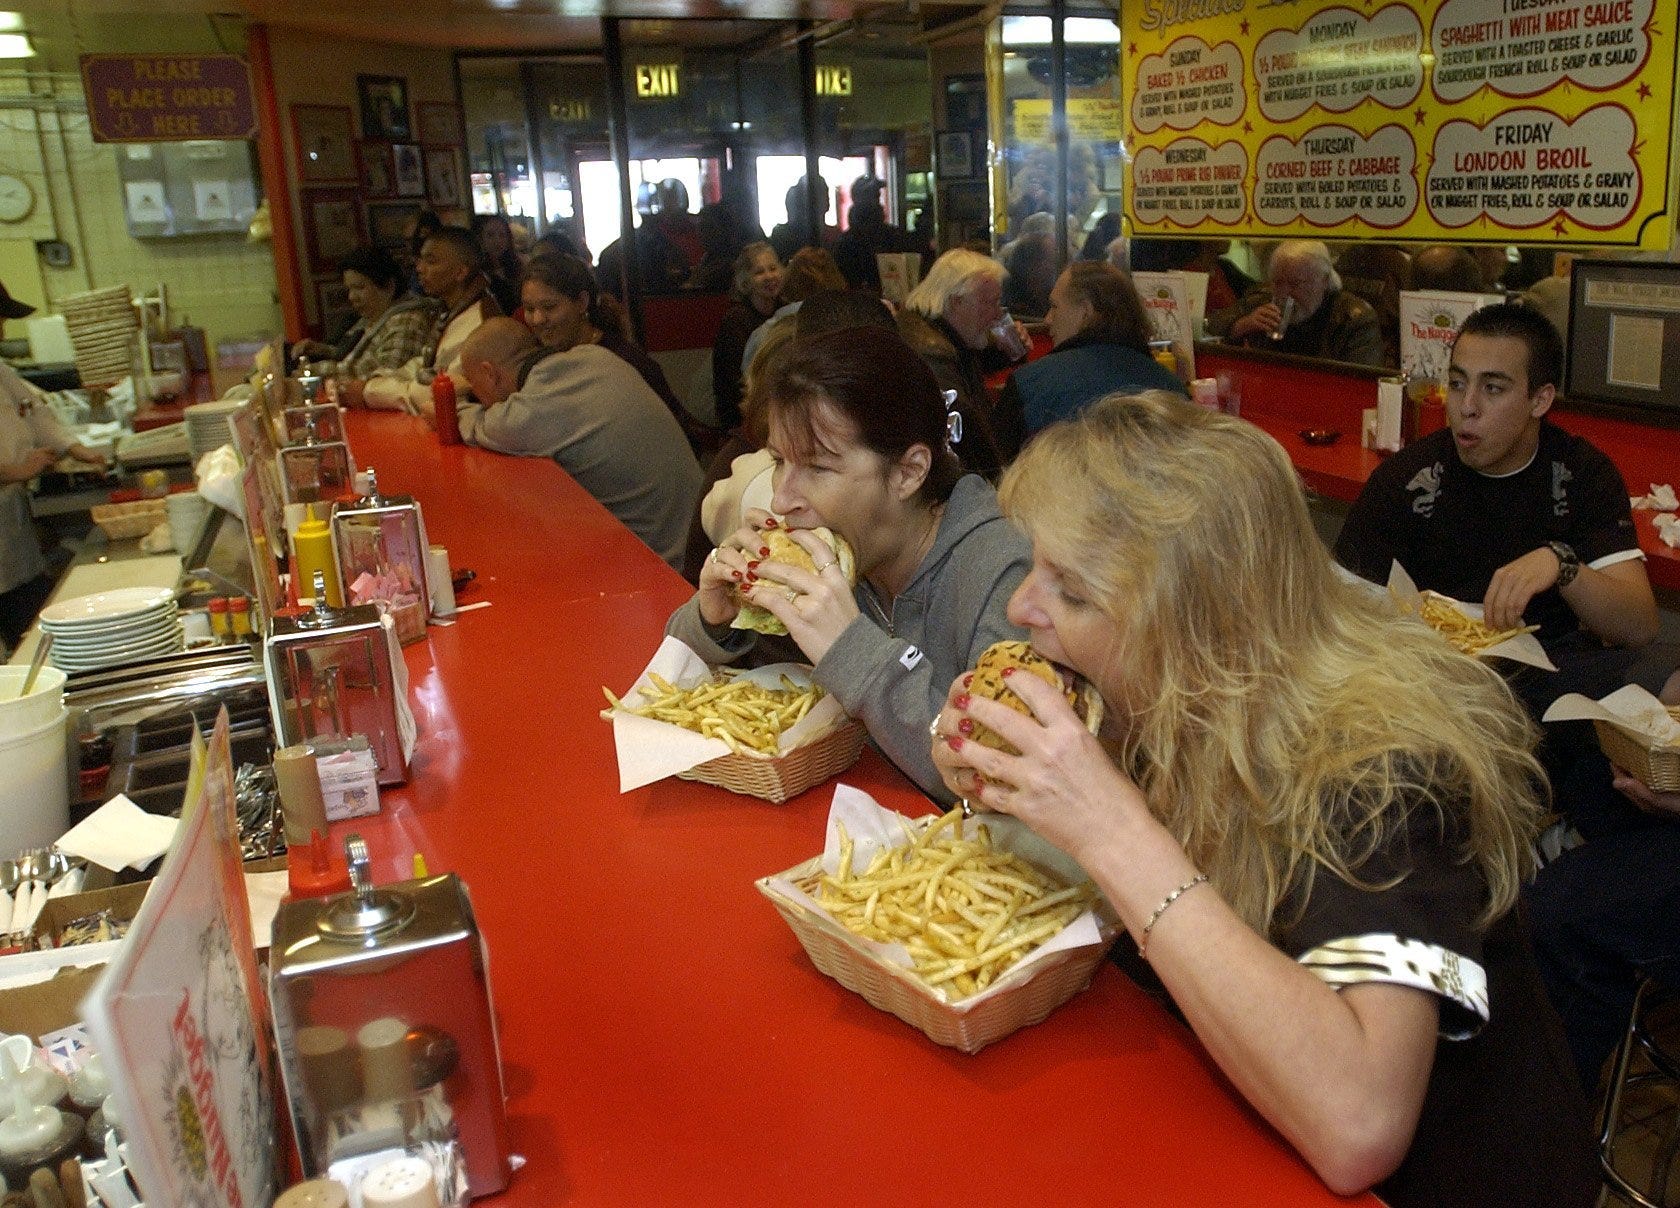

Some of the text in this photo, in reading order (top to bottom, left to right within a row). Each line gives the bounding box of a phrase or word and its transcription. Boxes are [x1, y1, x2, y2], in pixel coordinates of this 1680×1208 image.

[1309, 20, 1357, 44] MONDAY
[1440, 2, 1633, 48] SPAGHETTI WITH MEAT SAUCE
[1442, 28, 1633, 66] SERVED WITH A TOASTED CHEESE & GARLIC
[1170, 48, 1202, 68] SUNDAY
[1438, 49, 1637, 84] SOURDOUGH FRENCH ROLL & SOUP OR SALAD
[133, 60, 202, 80] PLEASE
[1147, 72, 1173, 89] BAKED
[1189, 63, 1228, 83] CHICKEN
[1267, 73, 1294, 88] SERVED
[1308, 70, 1314, 83] A
[636, 65, 680, 98] EXIT
[1203, 82, 1233, 95] POTATOES
[1264, 73, 1416, 103] WITH NUGGET FRIES & SOUP OR SALAD
[106, 87, 237, 108] PLACE ORDER
[1212, 96, 1233, 110] SALAD
[152, 115, 201, 134] HERE
[1495, 122, 1553, 146] FRIDAY
[1166, 148, 1207, 163] WEDNESDAY
[1304, 136, 1356, 156] THURSDAY
[1266, 156, 1400, 179] CORNED BEEF & CABBAGE
[1454, 147, 1592, 173] LONDON BROIL
[1177, 167, 1197, 181] PRIME
[1199, 166, 1212, 181] RIB
[1214, 164, 1240, 180] DINNER
[1430, 172, 1635, 192] SERVED WITH MASHED POTATOES & GRAVY
[1264, 178, 1401, 194] SERVED WITH BOILED POTATOES &
[1260, 194, 1406, 211] CARROTS, ROLL & SOUP OR SALAD
[1431, 192, 1629, 212] OR NUGGET FRIES, ROLL & SOUP OR SALAD
[1410, 321, 1457, 346] The Nugge
